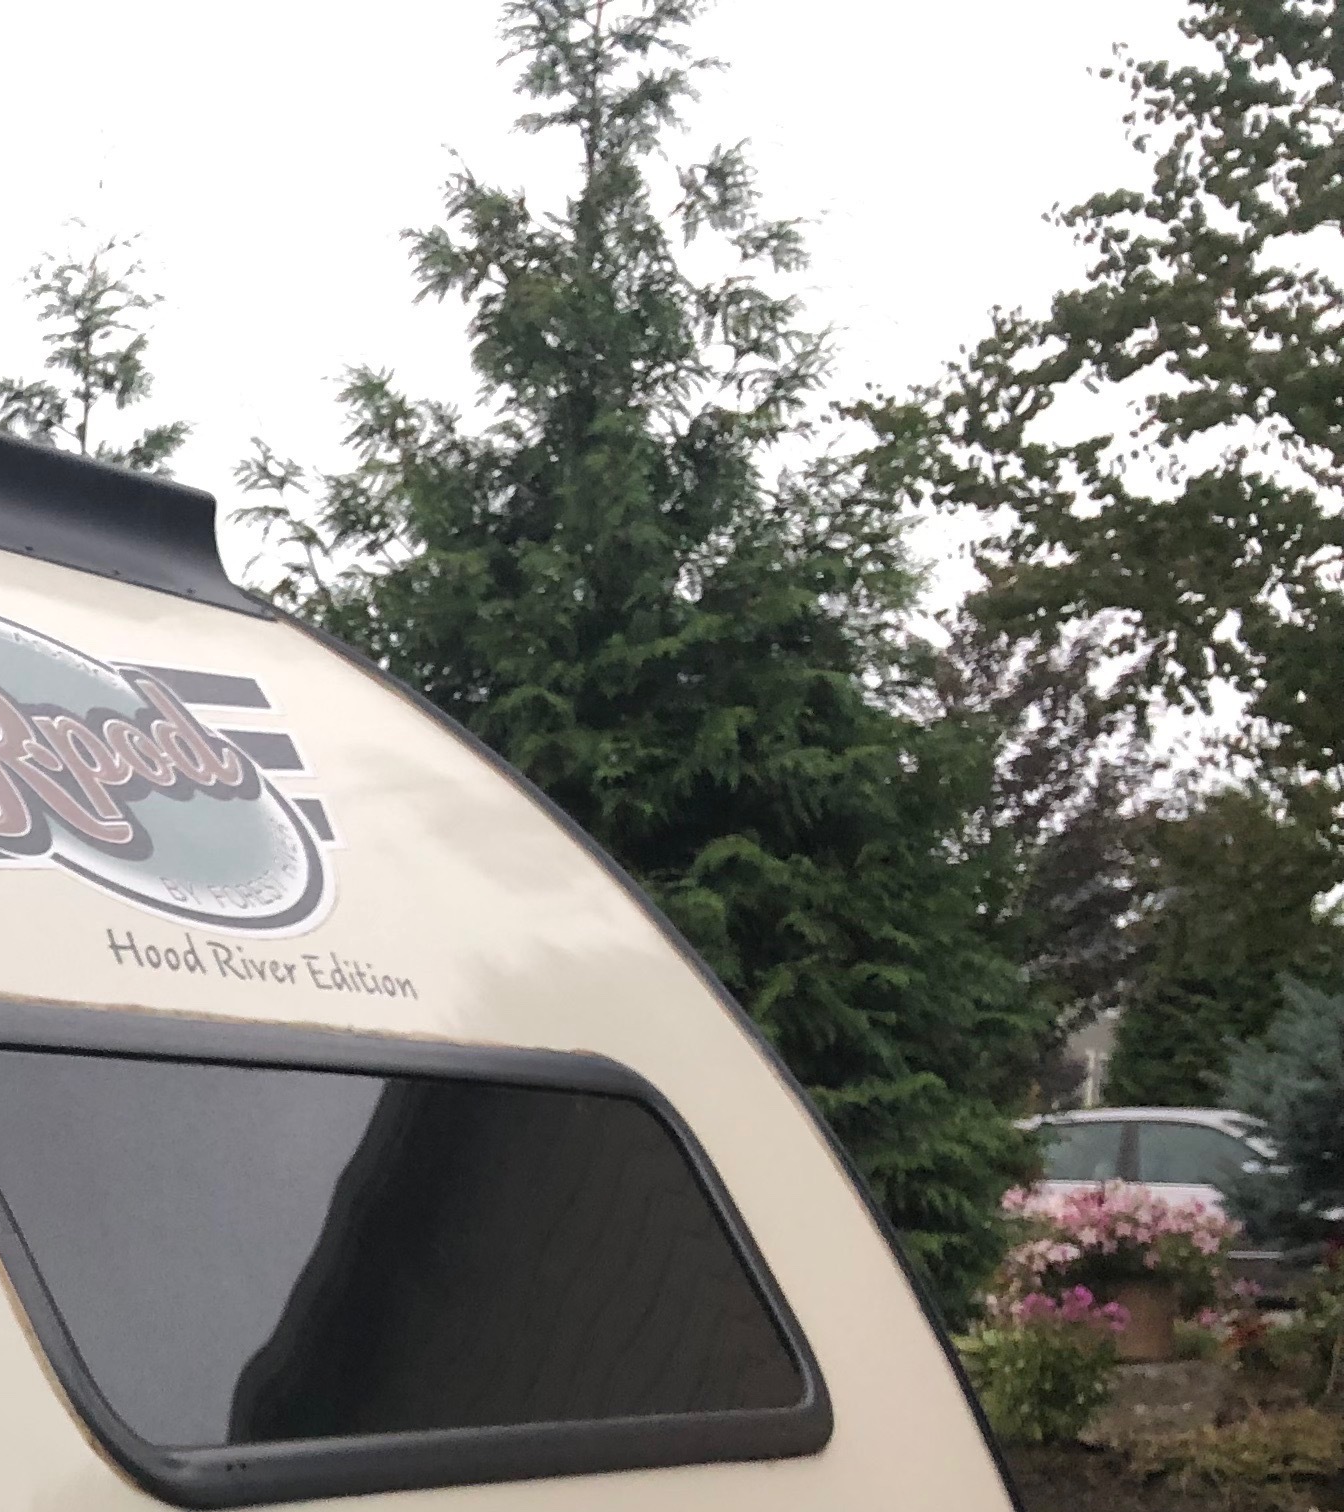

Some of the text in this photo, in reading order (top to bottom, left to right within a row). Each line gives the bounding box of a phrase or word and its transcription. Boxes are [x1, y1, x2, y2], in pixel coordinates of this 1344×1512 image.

[106, 928, 419, 1001] Hood River Edition
